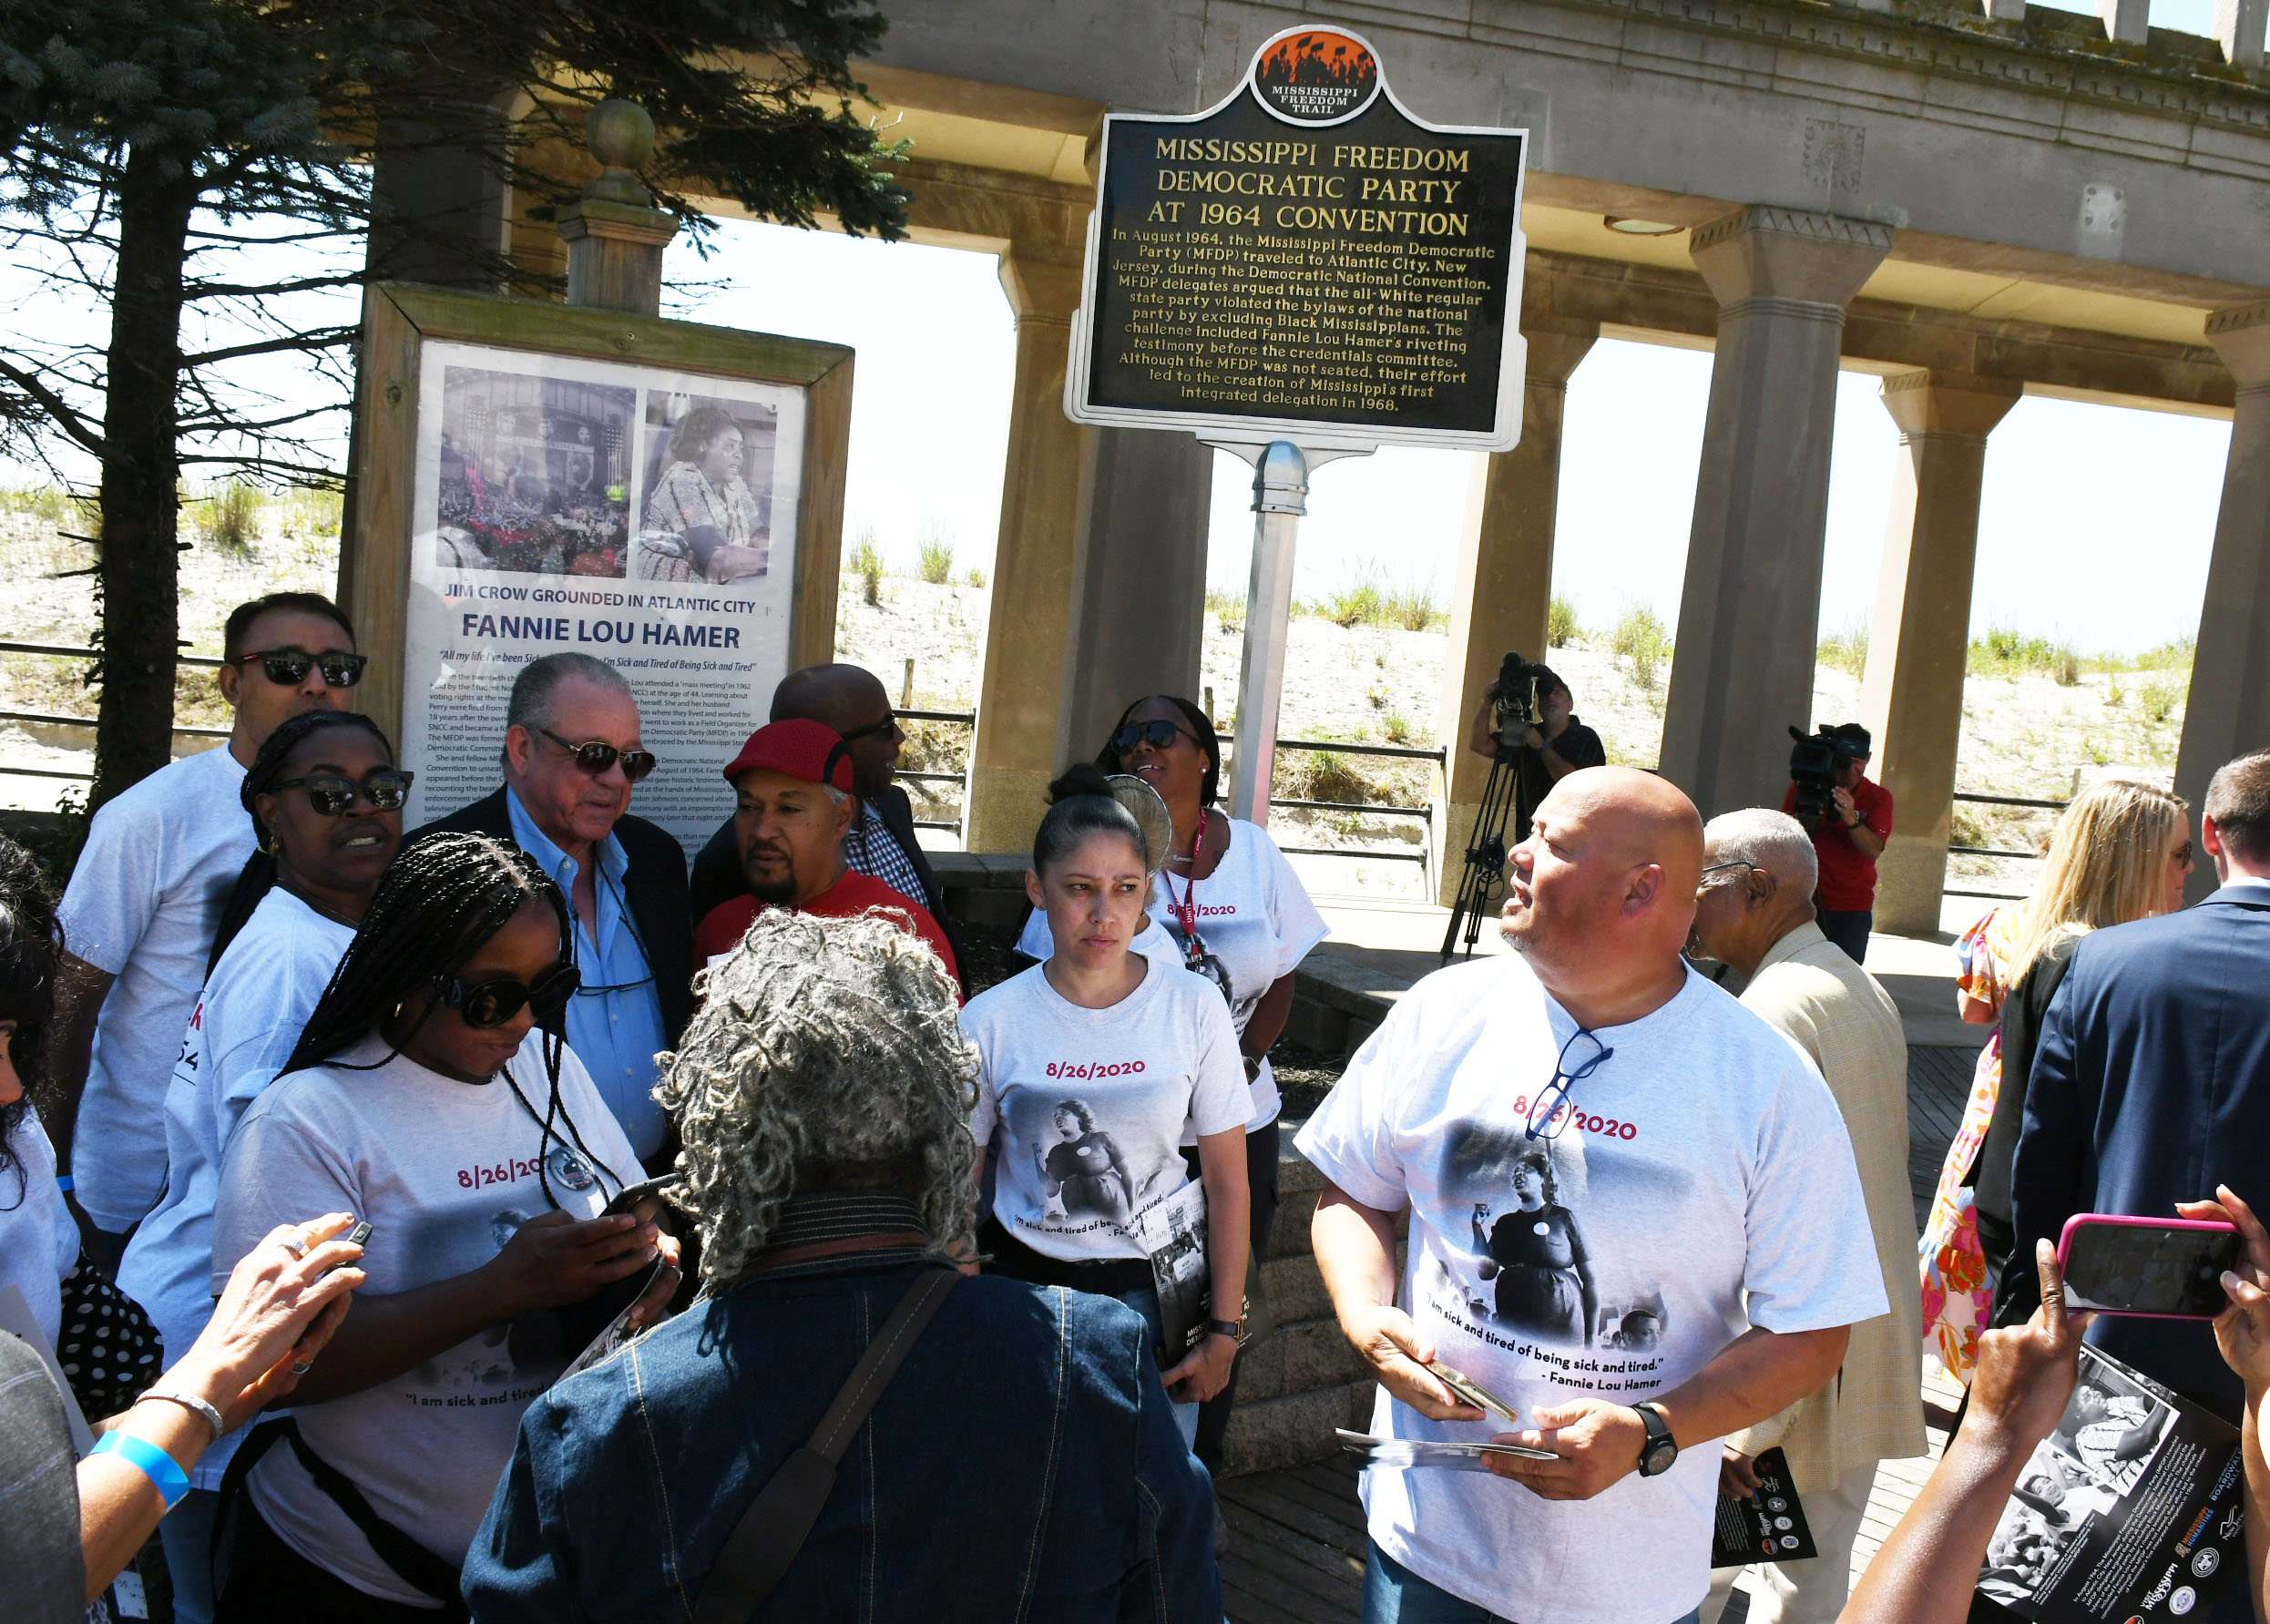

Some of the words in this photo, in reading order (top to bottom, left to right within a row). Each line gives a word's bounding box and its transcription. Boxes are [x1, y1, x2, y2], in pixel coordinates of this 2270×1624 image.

[1272, 86, 1357, 97] MISSISSIPPI
[1280, 95, 1347, 107] FREEDOM
[1292, 105, 1334, 114] TRAIL
[1156, 138, 1317, 166] MISSISSIPPI
[1333, 146, 1469, 172] FREEDOM
[1158, 169, 1345, 198] DEMOCRATIC
[1360, 178, 1461, 203] PARTY
[1147, 200, 1185, 223] AT
[1200, 204, 1261, 226] 1964
[1276, 205, 1468, 236] CONVENTION
[1113, 229, 1127, 240] In
[1133, 230, 1181, 243] August
[1228, 234, 1253, 246] the
[1257, 235, 1335, 253] Mississippi
[1339, 240, 1404, 253] Freedom
[1408, 242, 1495, 258] Democratic
[1140, 245, 1181, 260] Party
[1242, 250, 1304, 264] traveled
[1308, 254, 1324, 265] to
[1327, 255, 1388, 269] Atlantic
[1435, 260, 1467, 272] New
[1168, 263, 1216, 278] during
[1221, 265, 1245, 277] the
[1248, 266, 1333, 281] Democratic
[1336, 271, 1398, 285] National
[1119, 275, 1159, 288] MFDP
[1161, 278, 1229, 292] delegates
[1232, 284, 1284, 295] argued
[1288, 284, 1321, 296] that
[1324, 286, 1349, 298] the
[1426, 293, 1483, 306] regular
[1130, 292, 1164, 303] state
[1168, 295, 1211, 308] party
[1213, 296, 1272, 310] violated
[1274, 299, 1299, 311] the
[1303, 301, 1355, 315] bylaws
[1358, 304, 1375, 315] of
[1377, 305, 1403, 317] the
[1407, 308, 1467, 321] national
[1132, 309, 1174, 322] party
[1179, 310, 1198, 323] by
[1201, 312, 1273, 328] excluding
[1277, 315, 1318, 328] Black
[1434, 323, 1463, 335] The
[1125, 322, 1192, 337] challenge
[1196, 325, 1257, 340] included
[1262, 329, 1310, 342] Fannie
[1315, 332, 1340, 344] Lou
[1406, 338, 1467, 354] riveting
[1134, 338, 1205, 354] testimony
[1210, 342, 1258, 355] before
[1262, 344, 1286, 357] the
[1289, 349, 1373, 362] credentials
[1119, 352, 1184, 368] Although
[1188, 356, 1213, 367] the
[1216, 358, 1258, 370] MFDP
[1262, 363, 1288, 372] was
[1292, 363, 1317, 373] not
[1378, 367, 1417, 380] their
[1420, 370, 1467, 383] effort
[1150, 369, 1172, 381] led
[1176, 371, 1191, 382] to
[1196, 372, 1220, 383] the
[1223, 375, 1285, 388] creation
[1290, 378, 1306, 389] of
[1400, 385, 1434, 397] first
[1181, 386, 1258, 402] integrated
[1263, 392, 1338, 407] delegation
[1342, 397, 1356, 408] in
[445, 584, 474, 598] JIM
[478, 586, 528, 601] CROW
[532, 588, 624, 608] GROUNDED
[628, 594, 644, 608] IN
[648, 596, 720, 613] ATLANTIC
[723, 600, 755, 614] CITY
[463, 613, 569, 641] FANNIE
[578, 619, 634, 644] LOU
[642, 623, 741, 649] HAMER
[455, 653, 470, 663] my
[471, 651, 485, 661] life
[503, 652, 523, 662] been
[616, 657, 633, 668] Sick
[633, 659, 649, 668] and
[649, 659, 670, 669] Tired
[670, 659, 679, 669] of
[679, 660, 701, 672] Being
[702, 661, 718, 670] Sick
[718, 662, 734, 671] and
[1046, 1059, 1146, 1081] 8/26/2020
[1065, 1226, 1087, 1234] tired
[1089, 1220, 1099, 1231] of
[1431, 1300, 1443, 1314] am
[1444, 1310, 1463, 1328] sick
[1464, 1322, 1483, 1340] and
[1485, 1331, 1516, 1353] tired
[1518, 1344, 1533, 1357] of
[1534, 1347, 1570, 1371] being
[1573, 1358, 1599, 1373] sick
[1602, 1361, 1625, 1374] and
[421, 1396, 443, 1407] am
[447, 1394, 475, 1407] sick
[481, 1391, 507, 1405] and
[512, 1383, 545, 1401] tired
[1549, 1372, 1594, 1390] Fannie
[1598, 1379, 1622, 1391] Lou
[1624, 1378, 1662, 1391] Hamer
[2182, 1507, 2209, 1544] MISSISSIPPI
[2187, 1509, 2214, 1547] HUMANITIES
[2140, 1589, 2153, 1609] VISIT
